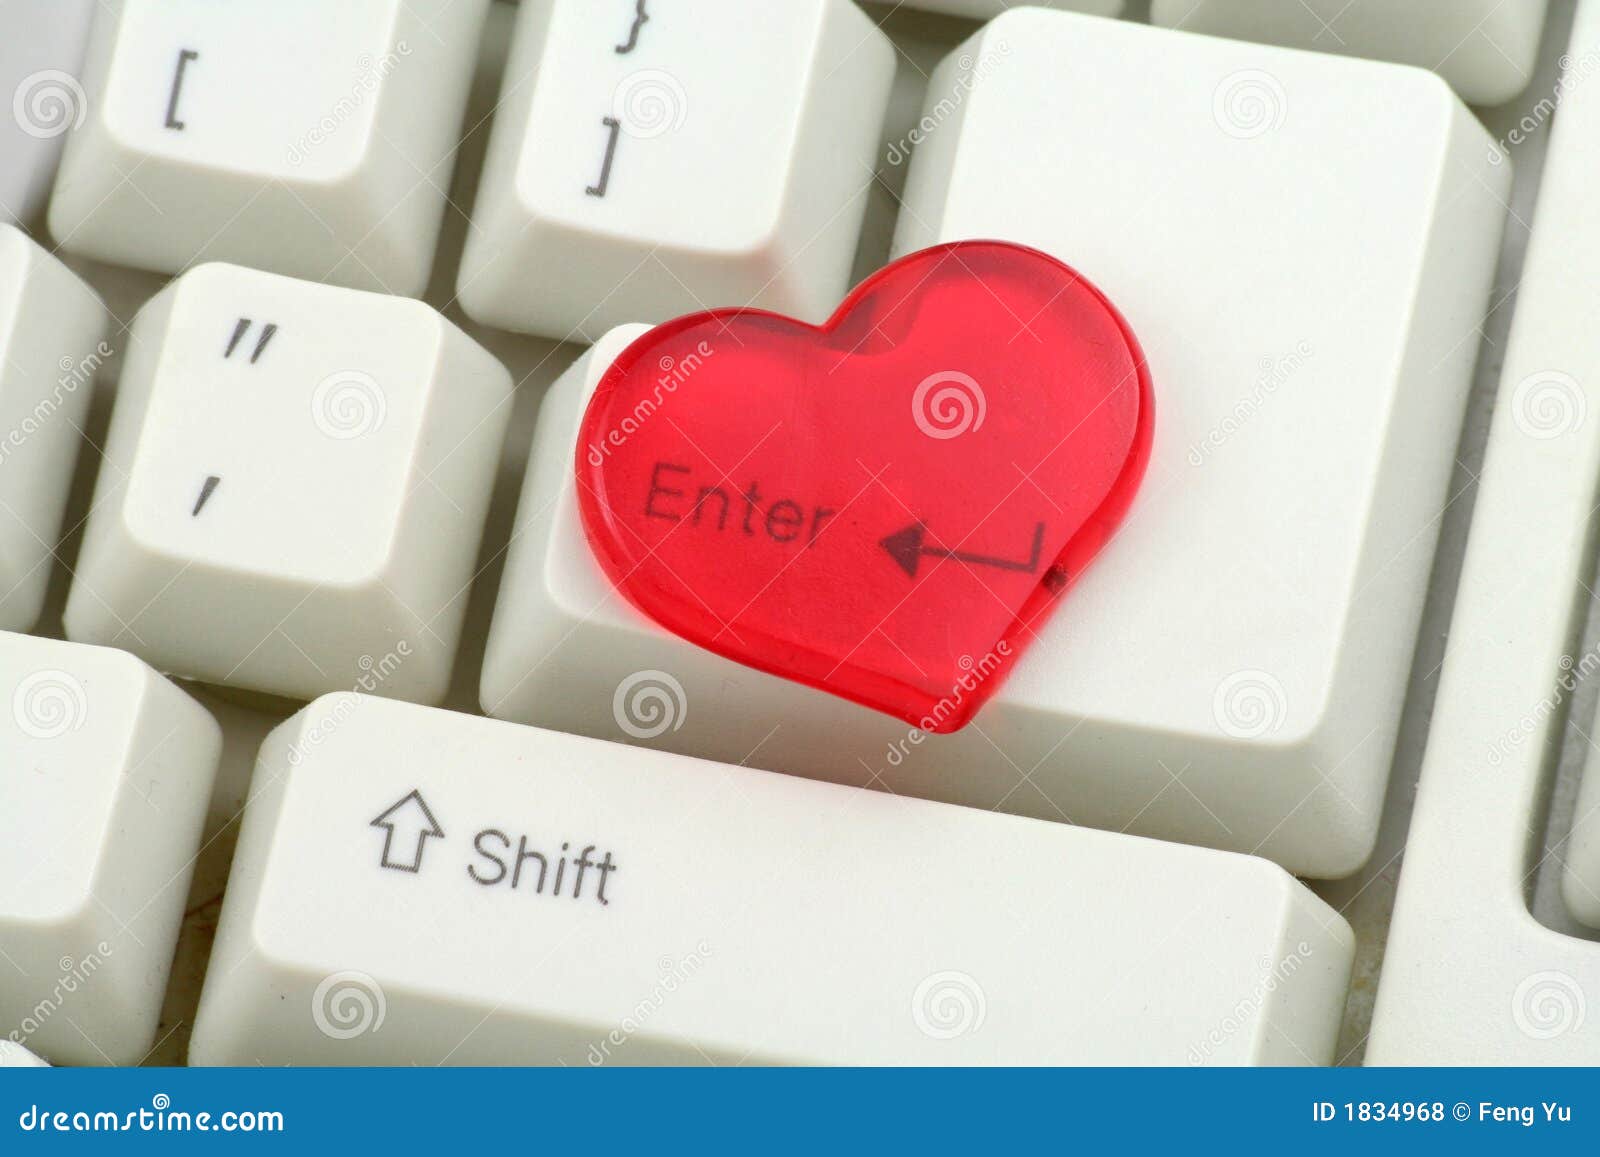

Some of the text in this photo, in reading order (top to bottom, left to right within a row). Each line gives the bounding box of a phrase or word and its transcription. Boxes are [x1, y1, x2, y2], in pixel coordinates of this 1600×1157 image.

[165, 49, 199, 131] [
[586, 117, 620, 197] ]
[645, 462, 834, 549] Enter
[467, 828, 617, 905] Shift
